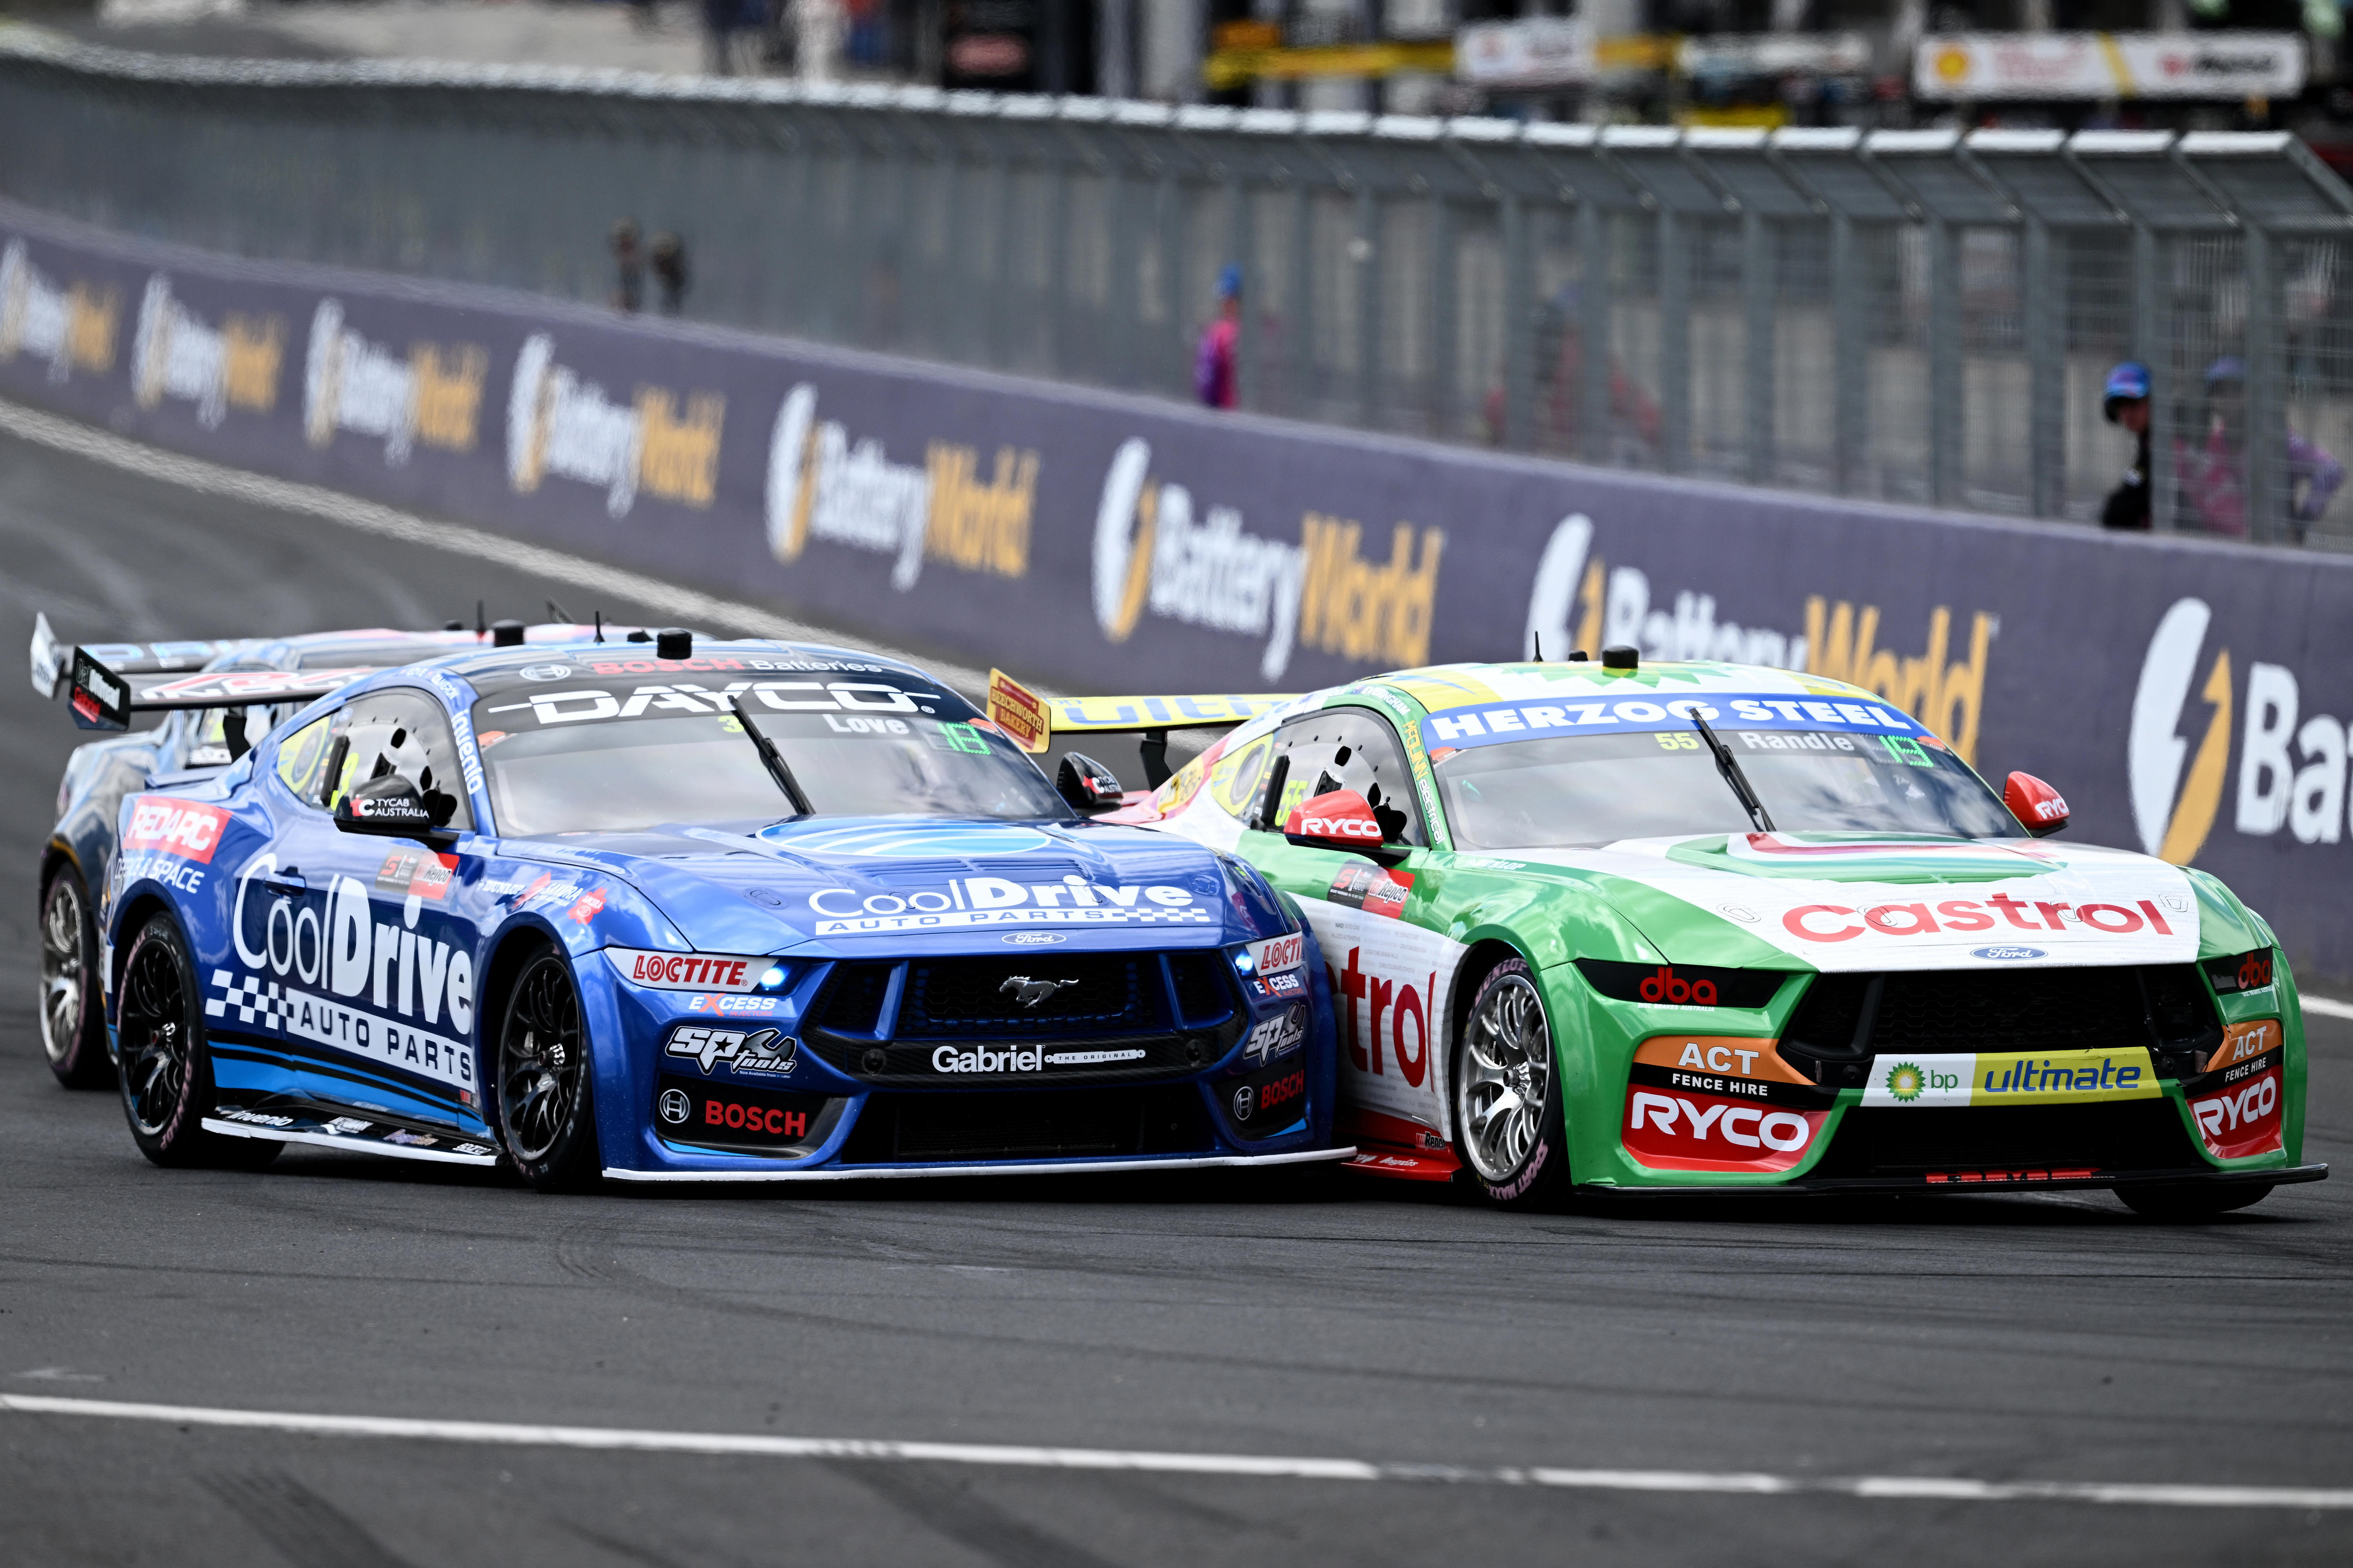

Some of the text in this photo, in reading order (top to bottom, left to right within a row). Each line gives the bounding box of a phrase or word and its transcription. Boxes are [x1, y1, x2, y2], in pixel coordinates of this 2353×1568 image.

[591, 659, 882, 674] BOSCH Batteries
[529, 682, 919, 724] DAYCO
[822, 713, 910, 734] Love
[1000, 709, 1032, 738] BAKERY
[1431, 700, 1912, 740] HERZOG STEEL
[1654, 732, 1855, 752] 55 Randle
[375, 807, 429, 818] AUSTRALIA
[376, 798, 410, 808] TYCAB
[1418, 779, 1446, 846] electrical
[128, 805, 217, 851] REDARC
[1301, 817, 1382, 837] RYCO
[149, 860, 205, 894] SPACE
[424, 862, 452, 886] Repco
[541, 882, 584, 902] SAKURA
[1378, 879, 1409, 904] Repco
[827, 910, 1104, 932] AUTO PARTS
[1014, 933, 1055, 944] Ford
[1986, 946, 2033, 959] Ford
[633, 955, 748, 986] LOCTITE
[2238, 952, 2271, 989] dba
[1252, 974, 1299, 997] EXCESS
[1640, 967, 1717, 1005] dba
[689, 993, 777, 1016] EXCESS
[300, 1001, 472, 1082] AUTO PARTS
[2232, 1025, 2267, 1061] ACT
[932, 1044, 1042, 1073] Gabriel
[1083, 1052, 1131, 1060] ORIGINAL
[1678, 1042, 1759, 1075] ACT
[2225, 1056, 2267, 1082] FENCE HIRE
[1261, 1069, 1305, 1109] BOSCH
[1672, 1073, 1768, 1096] FENCE HIRE
[1930, 1057, 2142, 1093] bp ultimate
[706, 1100, 806, 1137] BOSCH
[1631, 1091, 1809, 1152] RYCO
[2193, 1076, 2276, 1140] RYCO
